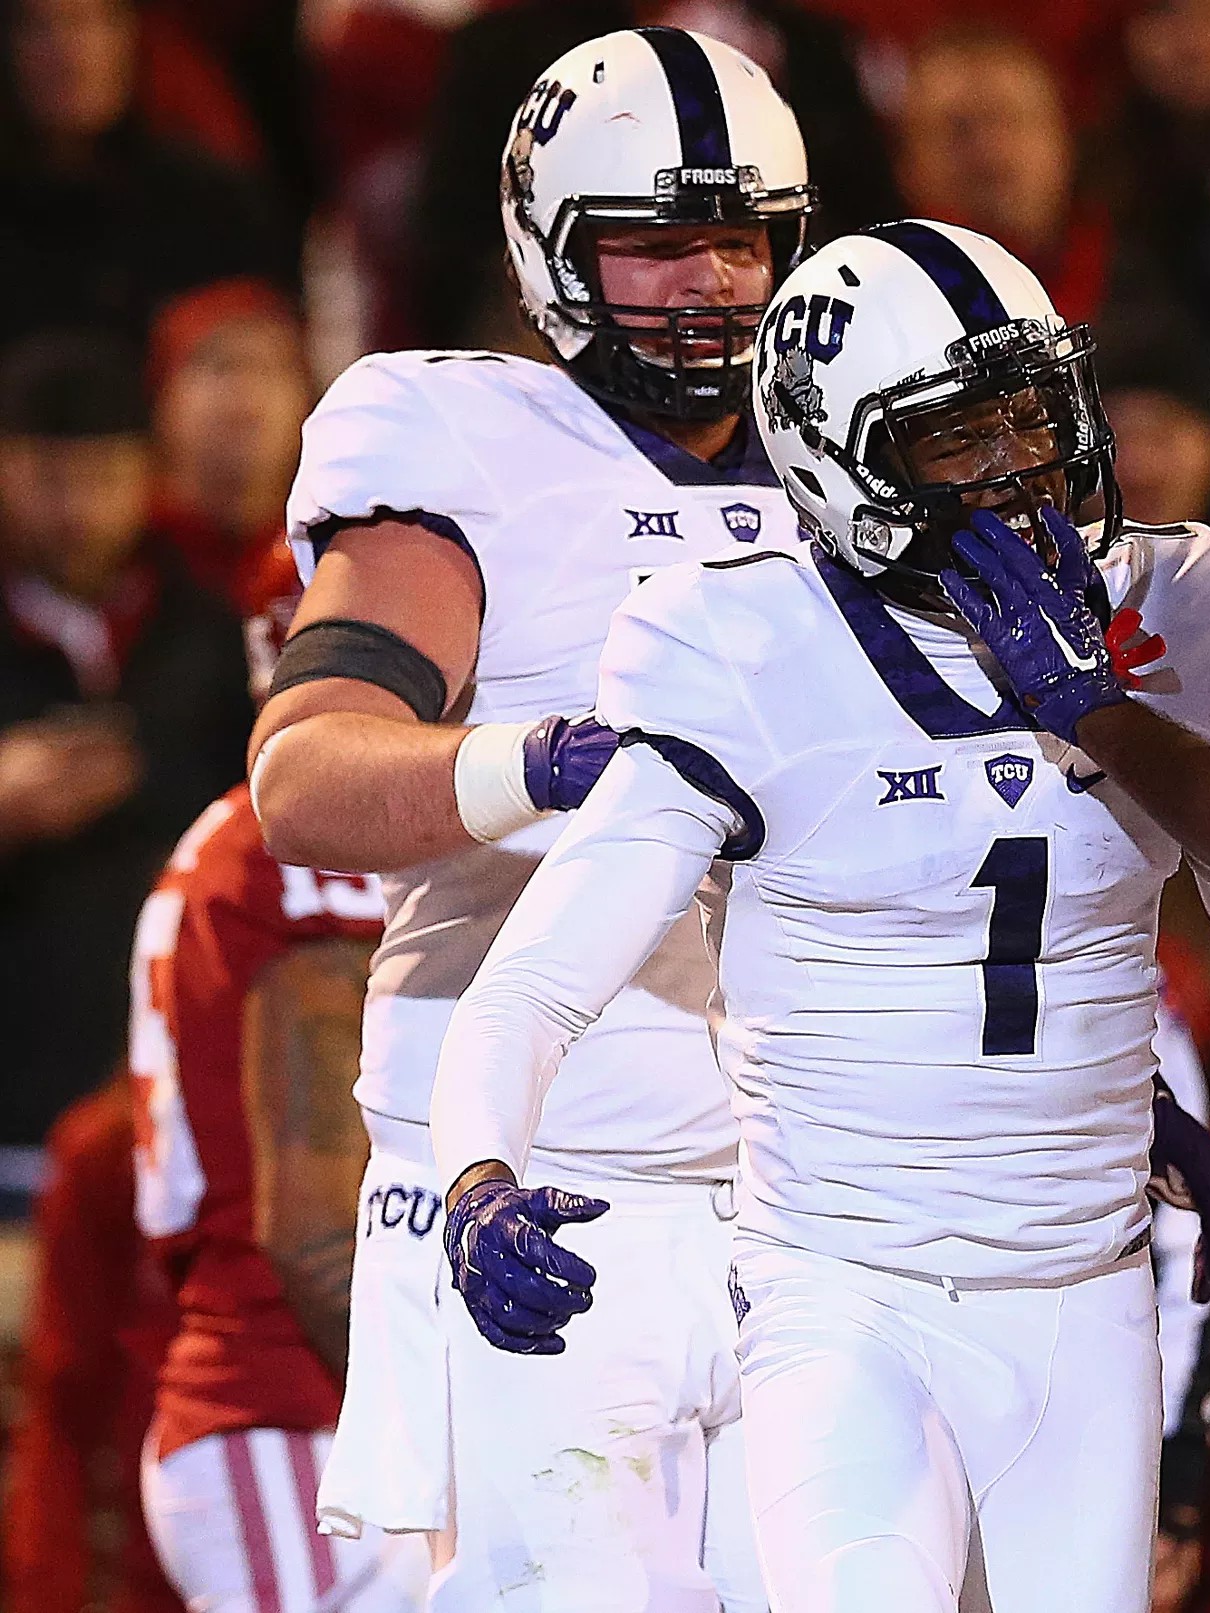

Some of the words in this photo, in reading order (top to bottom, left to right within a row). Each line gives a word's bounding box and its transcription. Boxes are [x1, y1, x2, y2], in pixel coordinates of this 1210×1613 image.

[680, 168, 737, 185] FROGS
[968, 322, 1020, 353] FROGS
[624, 508, 685, 540] XII
[876, 764, 945, 806] XII
[991, 763, 1029, 784] TCU
[969, 836, 1048, 1056] 1
